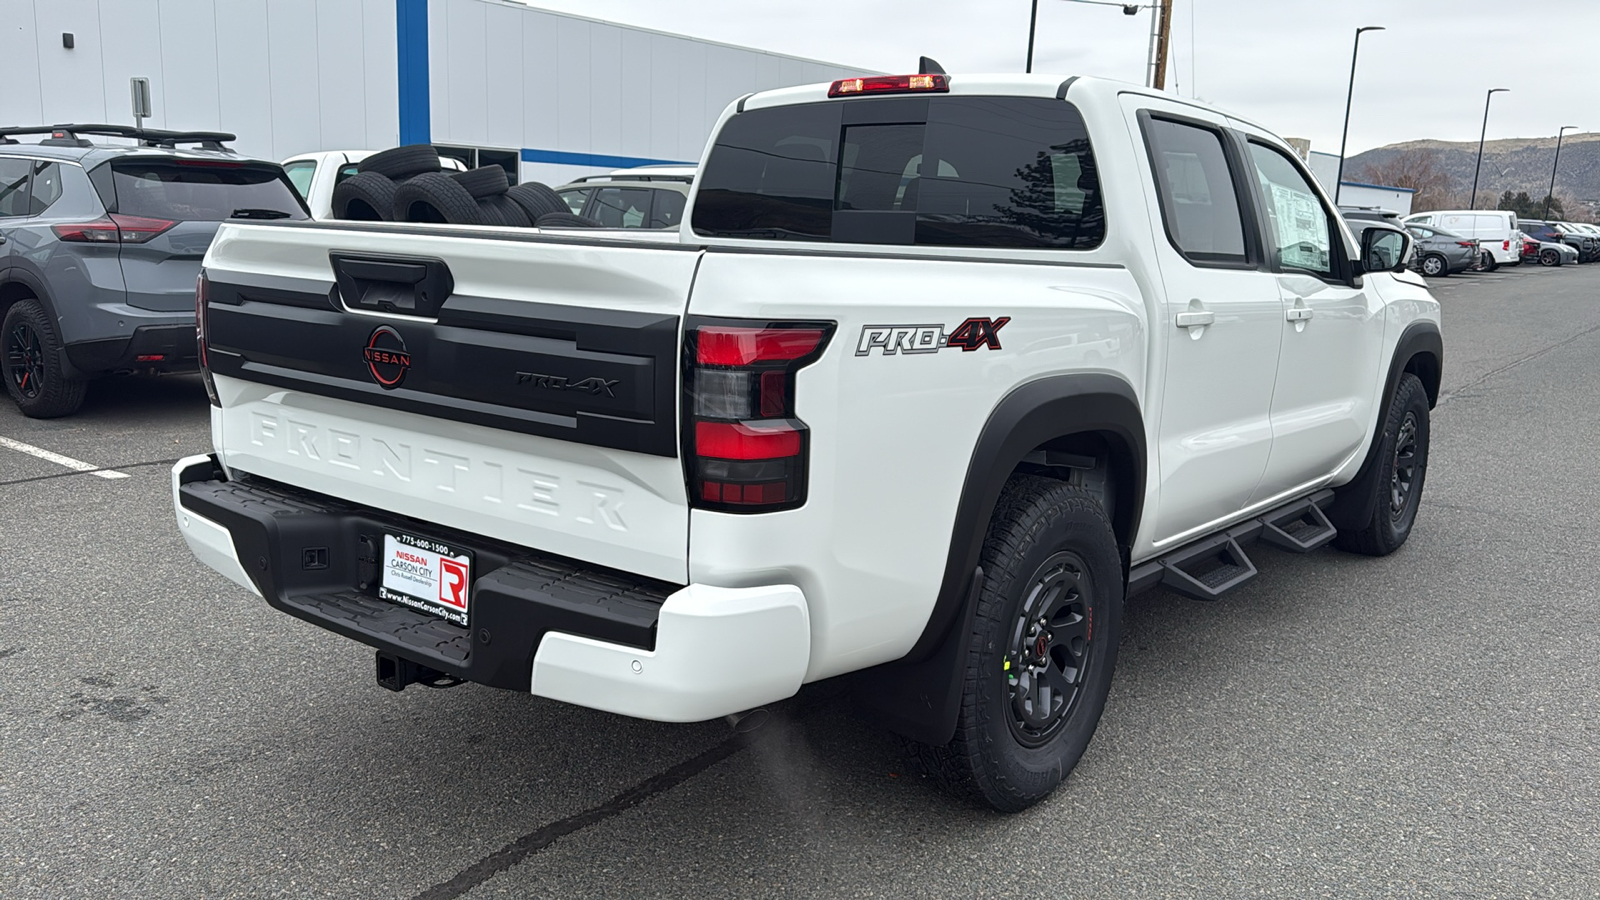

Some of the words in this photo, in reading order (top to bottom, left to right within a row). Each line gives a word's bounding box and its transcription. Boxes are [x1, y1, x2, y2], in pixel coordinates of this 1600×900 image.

[364, 349, 411, 367] NISSAN
[250, 410, 628, 532] FRONTIER
[402, 535, 449, 555] 775-600-1500
[396, 550, 428, 566] NISSAN
[391, 559, 418, 573] CARSON
[418, 566, 433, 578] CITY
[386, 592, 461, 620] www.NissanCarsonCity.com
